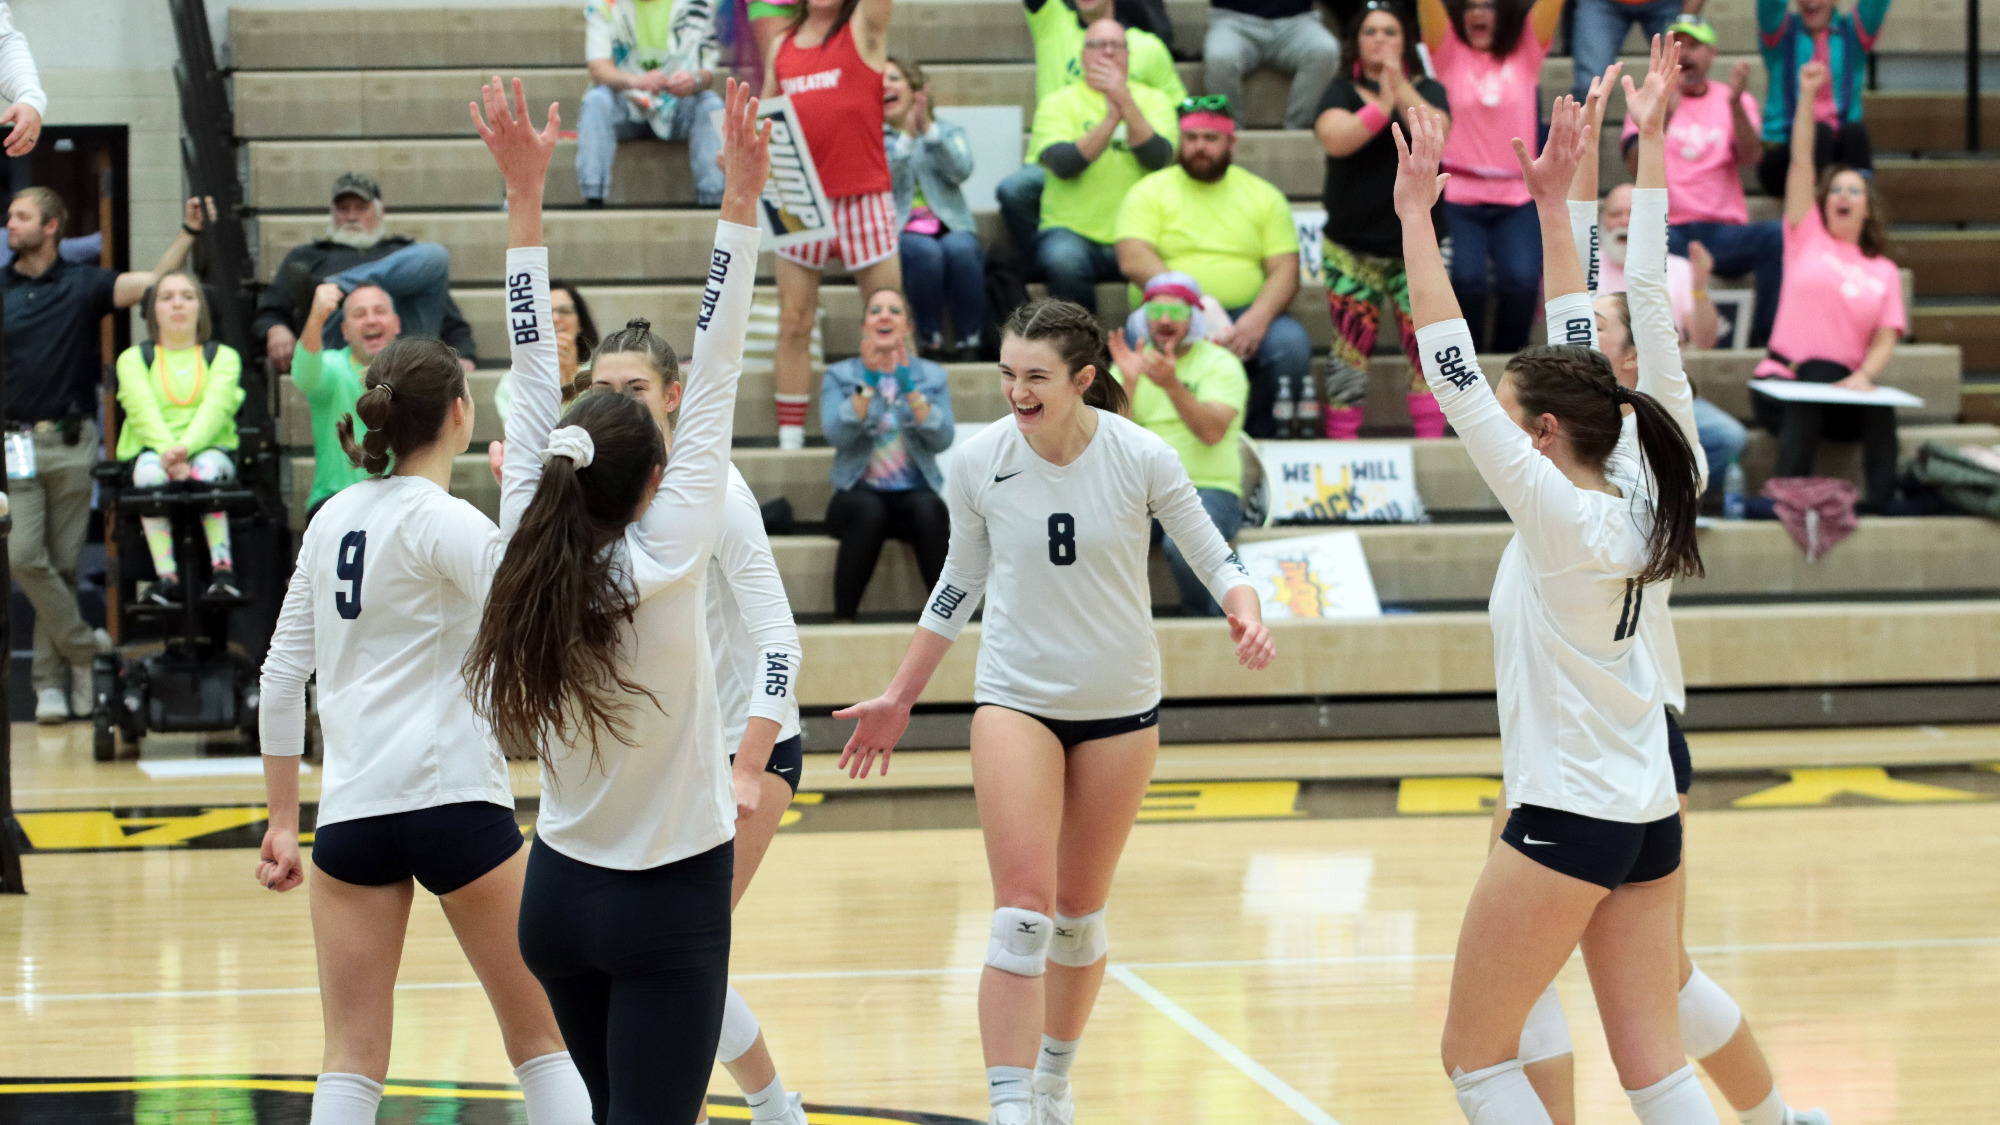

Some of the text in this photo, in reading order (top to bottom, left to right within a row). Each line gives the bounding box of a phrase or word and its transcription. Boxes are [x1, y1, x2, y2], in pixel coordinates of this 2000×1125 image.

[509, 272, 540, 345] BEARS
[697, 248, 731, 331] GOLDEN
[1282, 460, 1399, 482] WE WILL
[1293, 484, 1364, 519] OCK
[1048, 512, 1077, 566] 8
[335, 530, 366, 620] 9
[1613, 576, 1645, 642] 11
